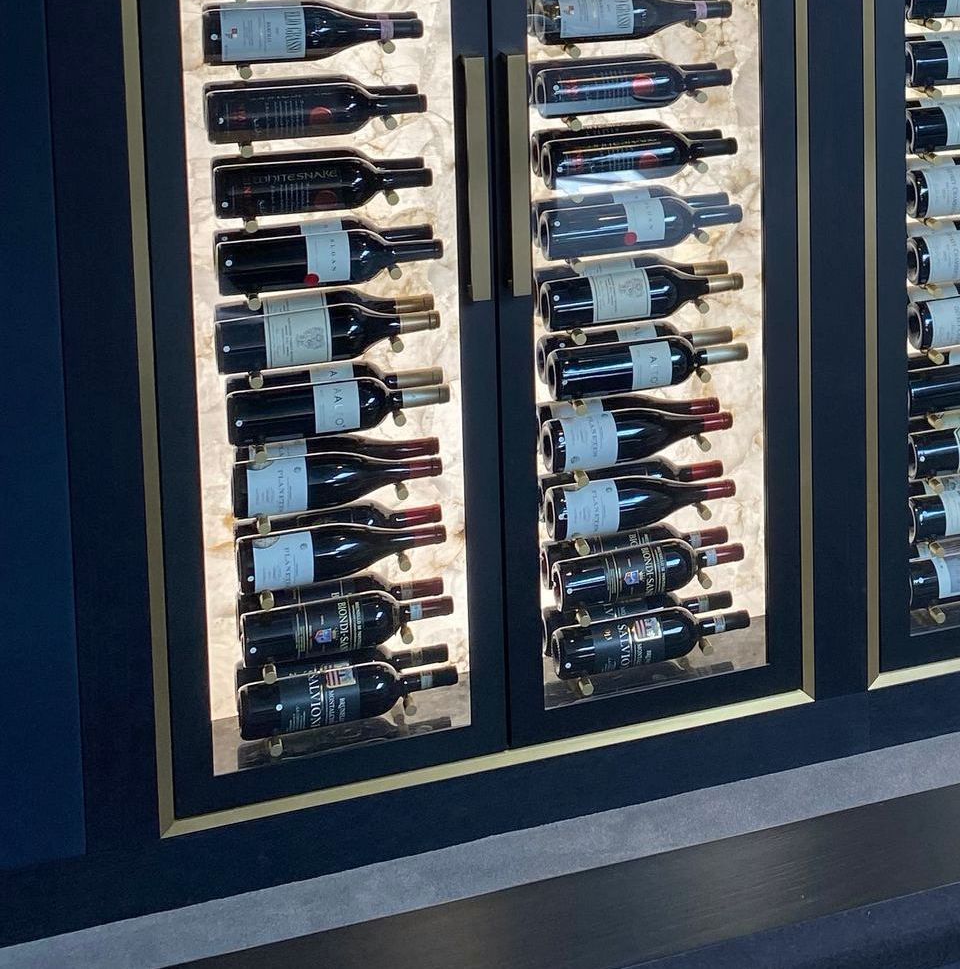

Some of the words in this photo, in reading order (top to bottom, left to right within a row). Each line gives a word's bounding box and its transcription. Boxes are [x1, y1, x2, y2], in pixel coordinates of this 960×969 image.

[641, 546, 655, 593] BIONDI-SAN
[337, 601, 349, 650] BIONDI-SAN
[617, 623, 631, 667] SALVIO
